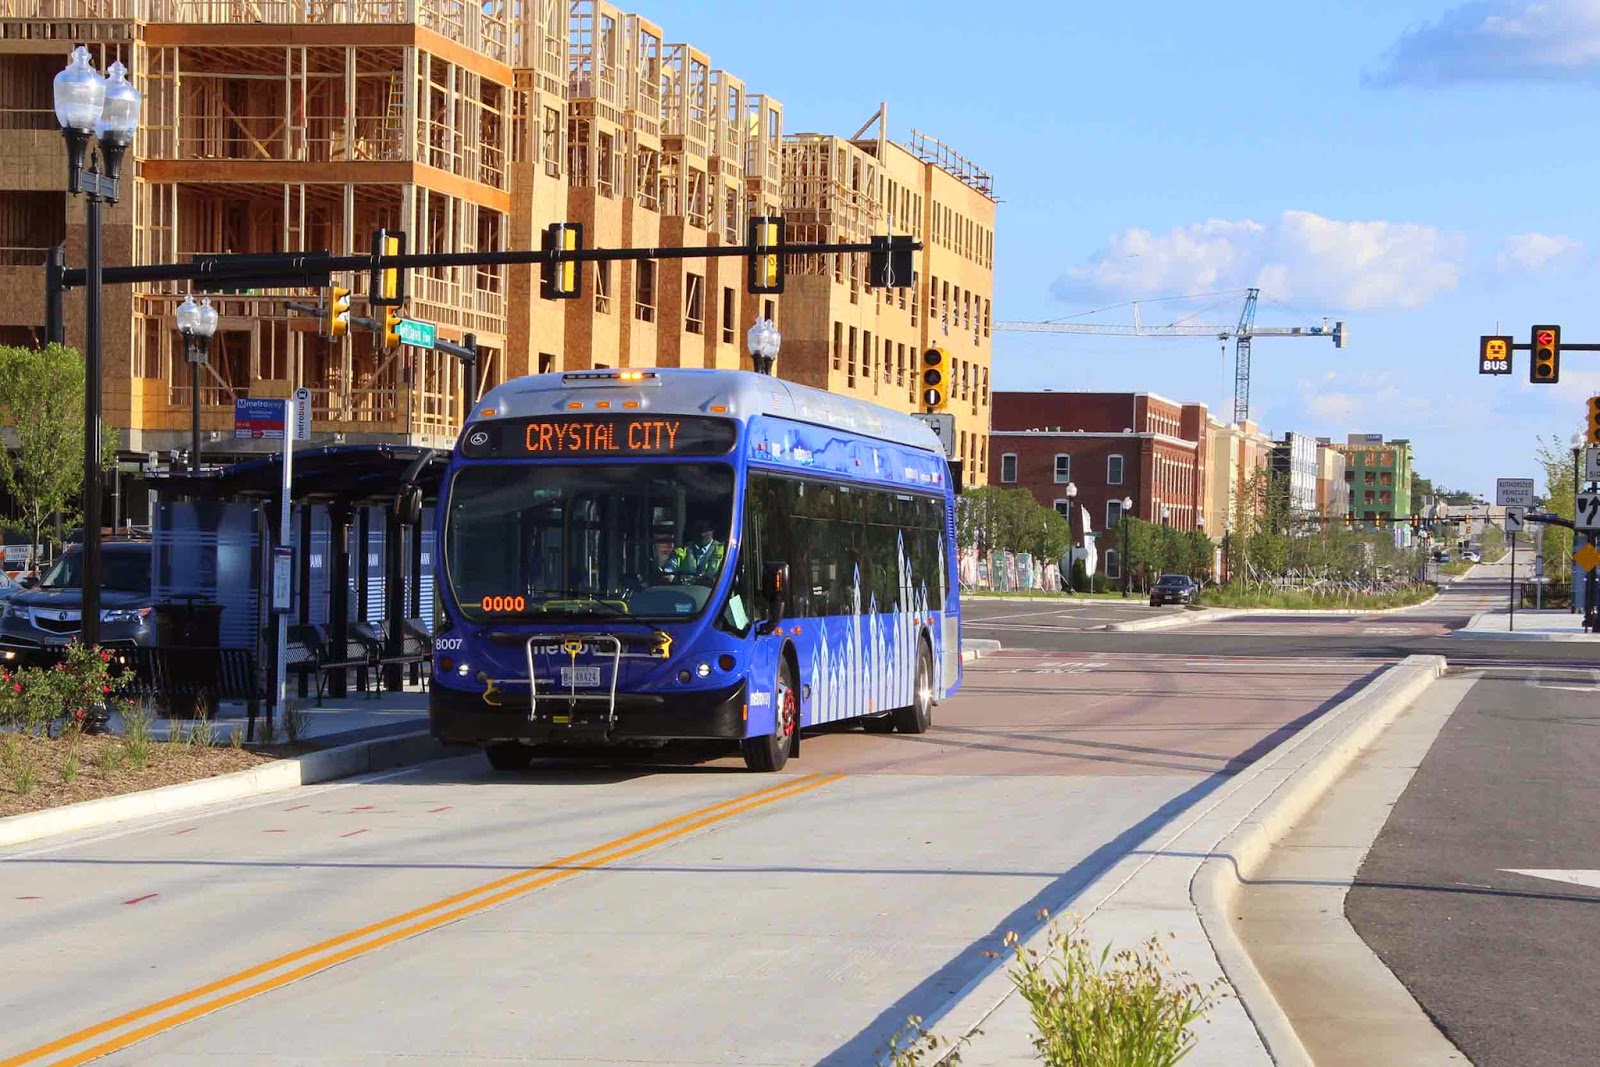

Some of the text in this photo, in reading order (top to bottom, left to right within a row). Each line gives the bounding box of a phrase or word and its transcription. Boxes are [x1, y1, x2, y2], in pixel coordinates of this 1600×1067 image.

[1483, 360, 1508, 371] BUS
[526, 421, 680, 451] CRYSTAL CITY
[482, 596, 525, 612] 0000
[435, 638, 462, 650] 8007
